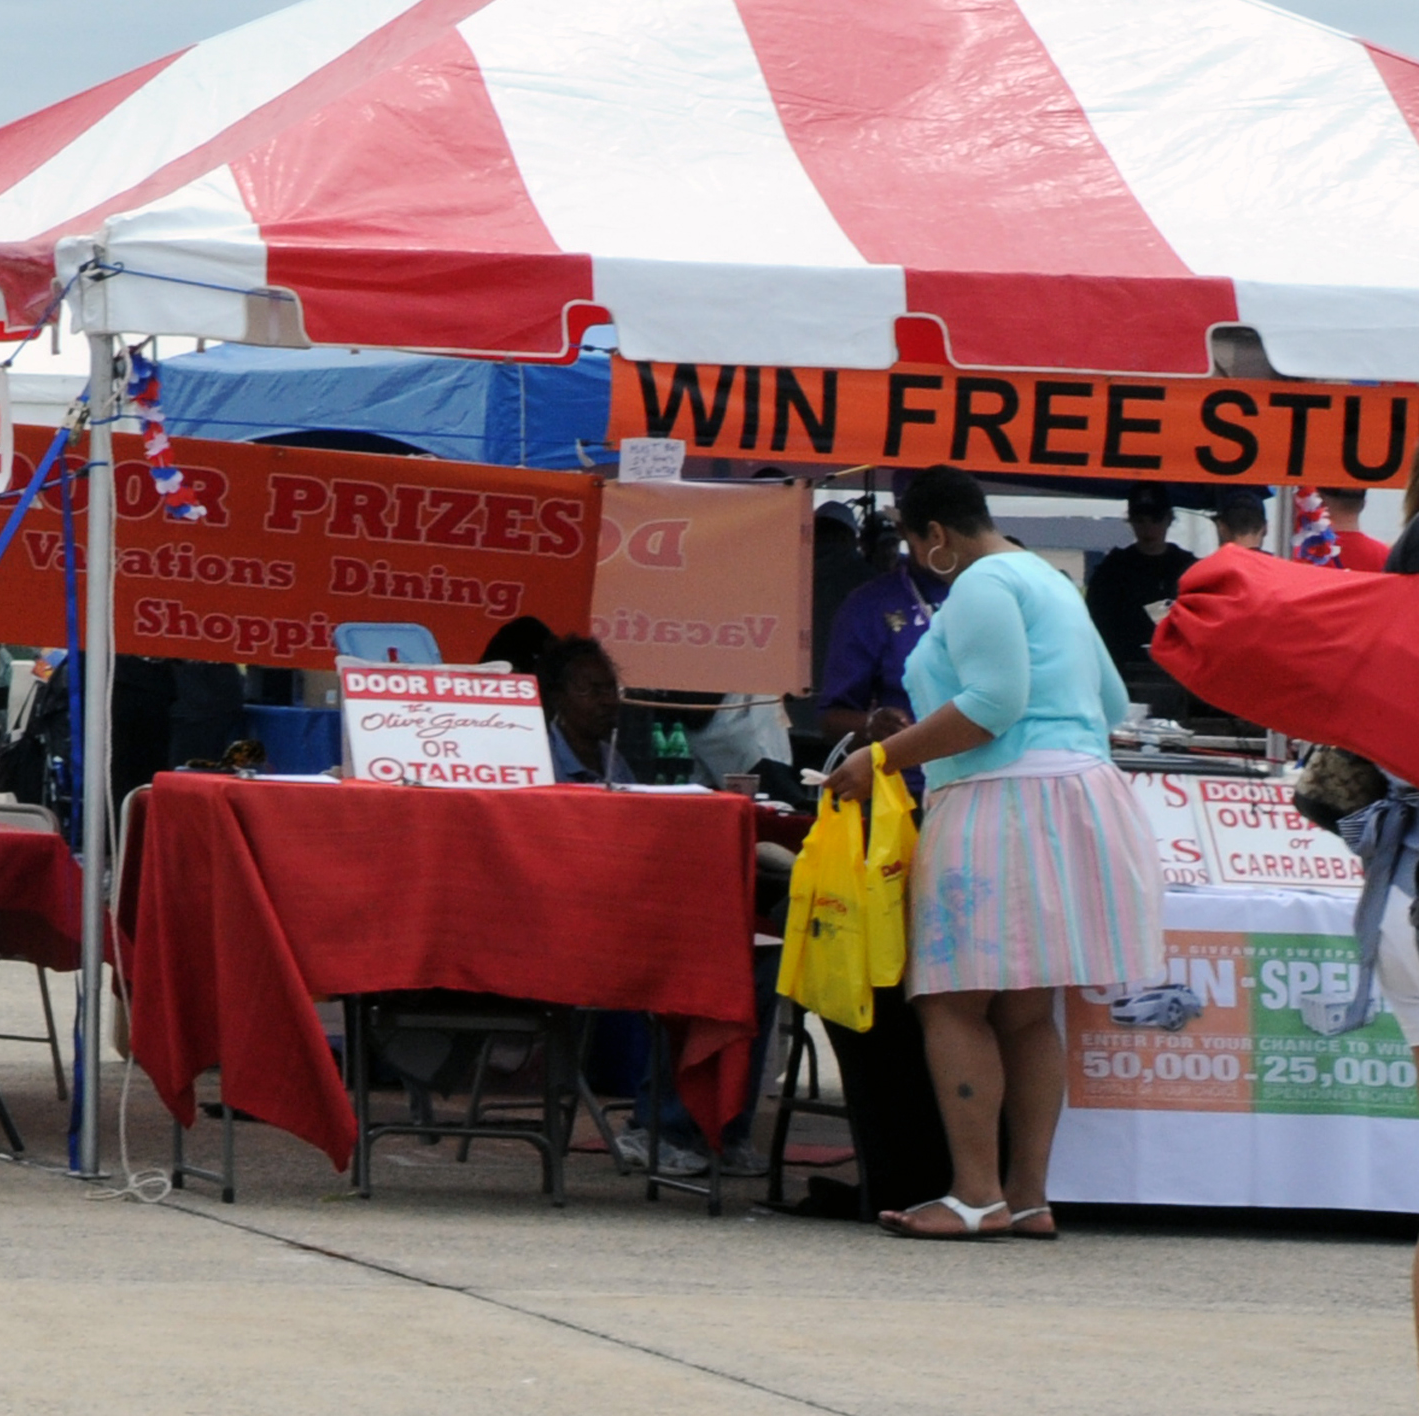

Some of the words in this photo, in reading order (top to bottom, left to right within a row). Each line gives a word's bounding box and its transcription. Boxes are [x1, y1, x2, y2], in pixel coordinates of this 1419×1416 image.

[636, 361, 838, 454] WIN
[882, 372, 1166, 470] FREE
[1195, 388, 1408, 482] STU
[264, 473, 584, 559] PRIZES
[23, 530, 295, 589] Vaations
[329, 556, 524, 618] Dining
[134, 597, 337, 657] Shoppi
[346, 673, 429, 695] DOOR
[433, 676, 537, 700] PRIZES
[361, 712, 424, 732] Olive
[415, 712, 535, 739] Garden
[422, 740, 462, 759] OR
[408, 762, 540, 785] TARGET
[1206, 781, 1279, 804] DOOR
[1290, 837, 1314, 849] or
[1230, 852, 1364, 882] CARRABBA
[1189, 945, 1279, 958] GIVEAWAY
[1286, 947, 1356, 960] SWEEPS
[1082, 1033, 1147, 1047] ENTER
[1156, 1035, 1194, 1049] FOR
[1201, 1037, 1253, 1051] YOUR
[1259, 1038, 1341, 1053] CHANCE
[1347, 1040, 1370, 1054] TO
